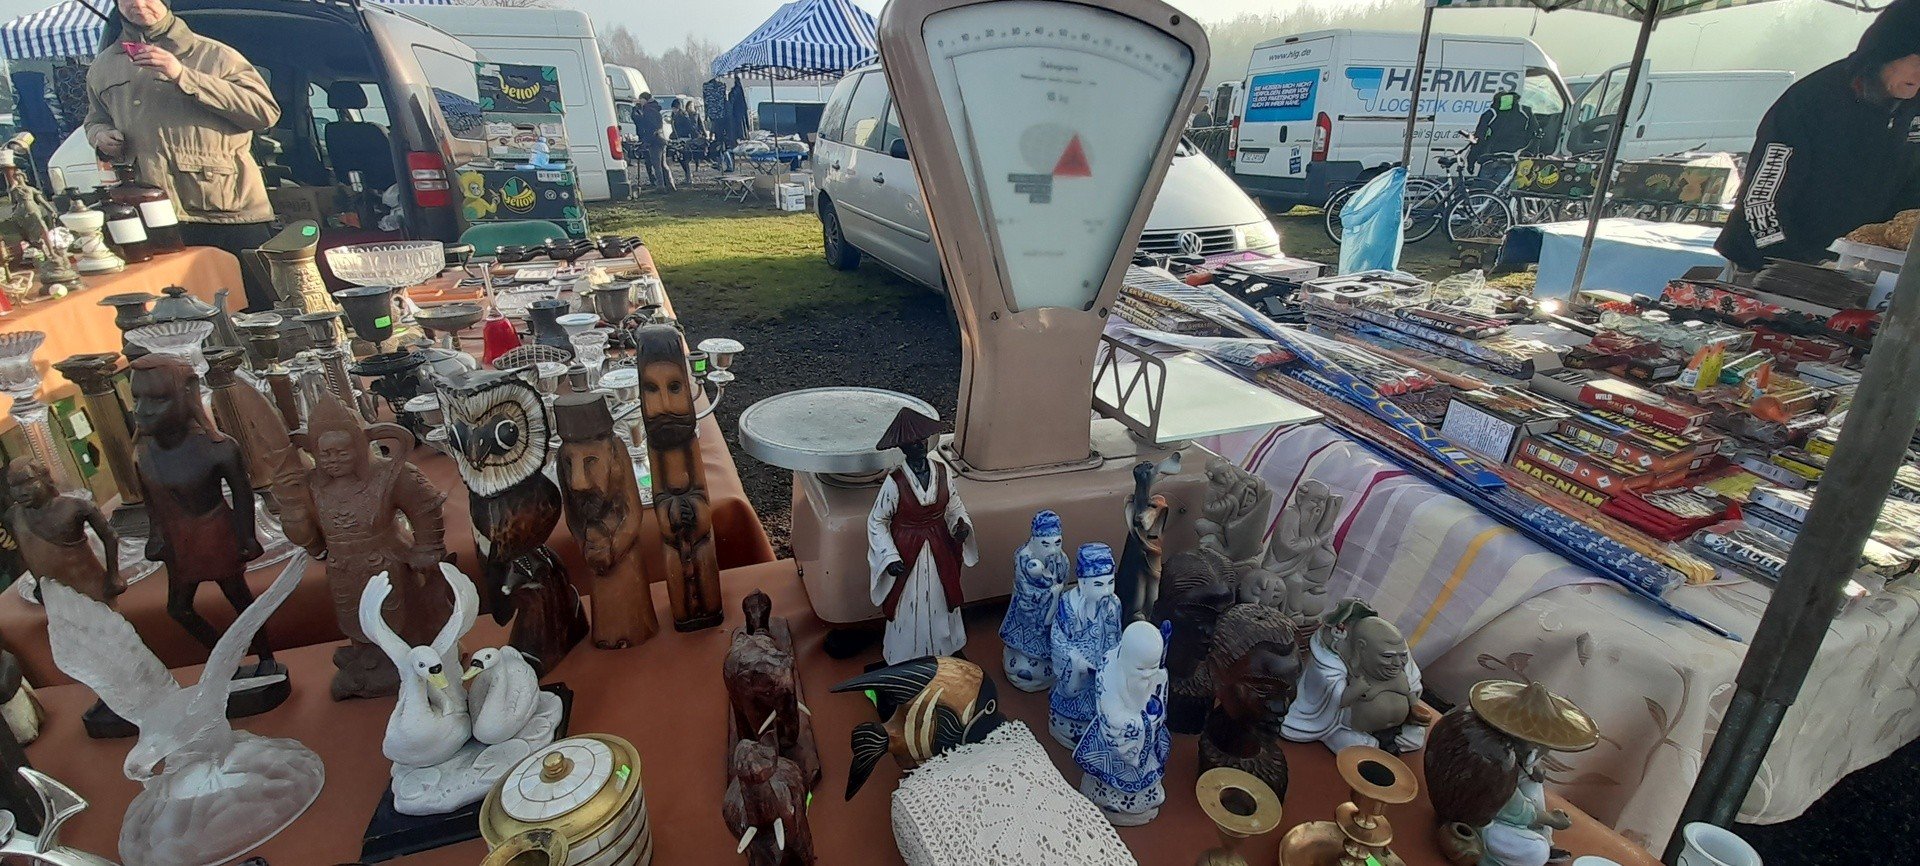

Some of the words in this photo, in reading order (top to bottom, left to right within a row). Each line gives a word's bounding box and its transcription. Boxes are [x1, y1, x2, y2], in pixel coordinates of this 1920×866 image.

[1385, 67, 1519, 93] HERMES
[501, 82, 541, 100] yellow
[1378, 98, 1446, 113] LOGSTIK
[1433, 130, 1452, 141] gut
[502, 191, 536, 207] yellow
[1595, 393, 1613, 401] WILD
[1515, 459, 1604, 508] MAGNUM
